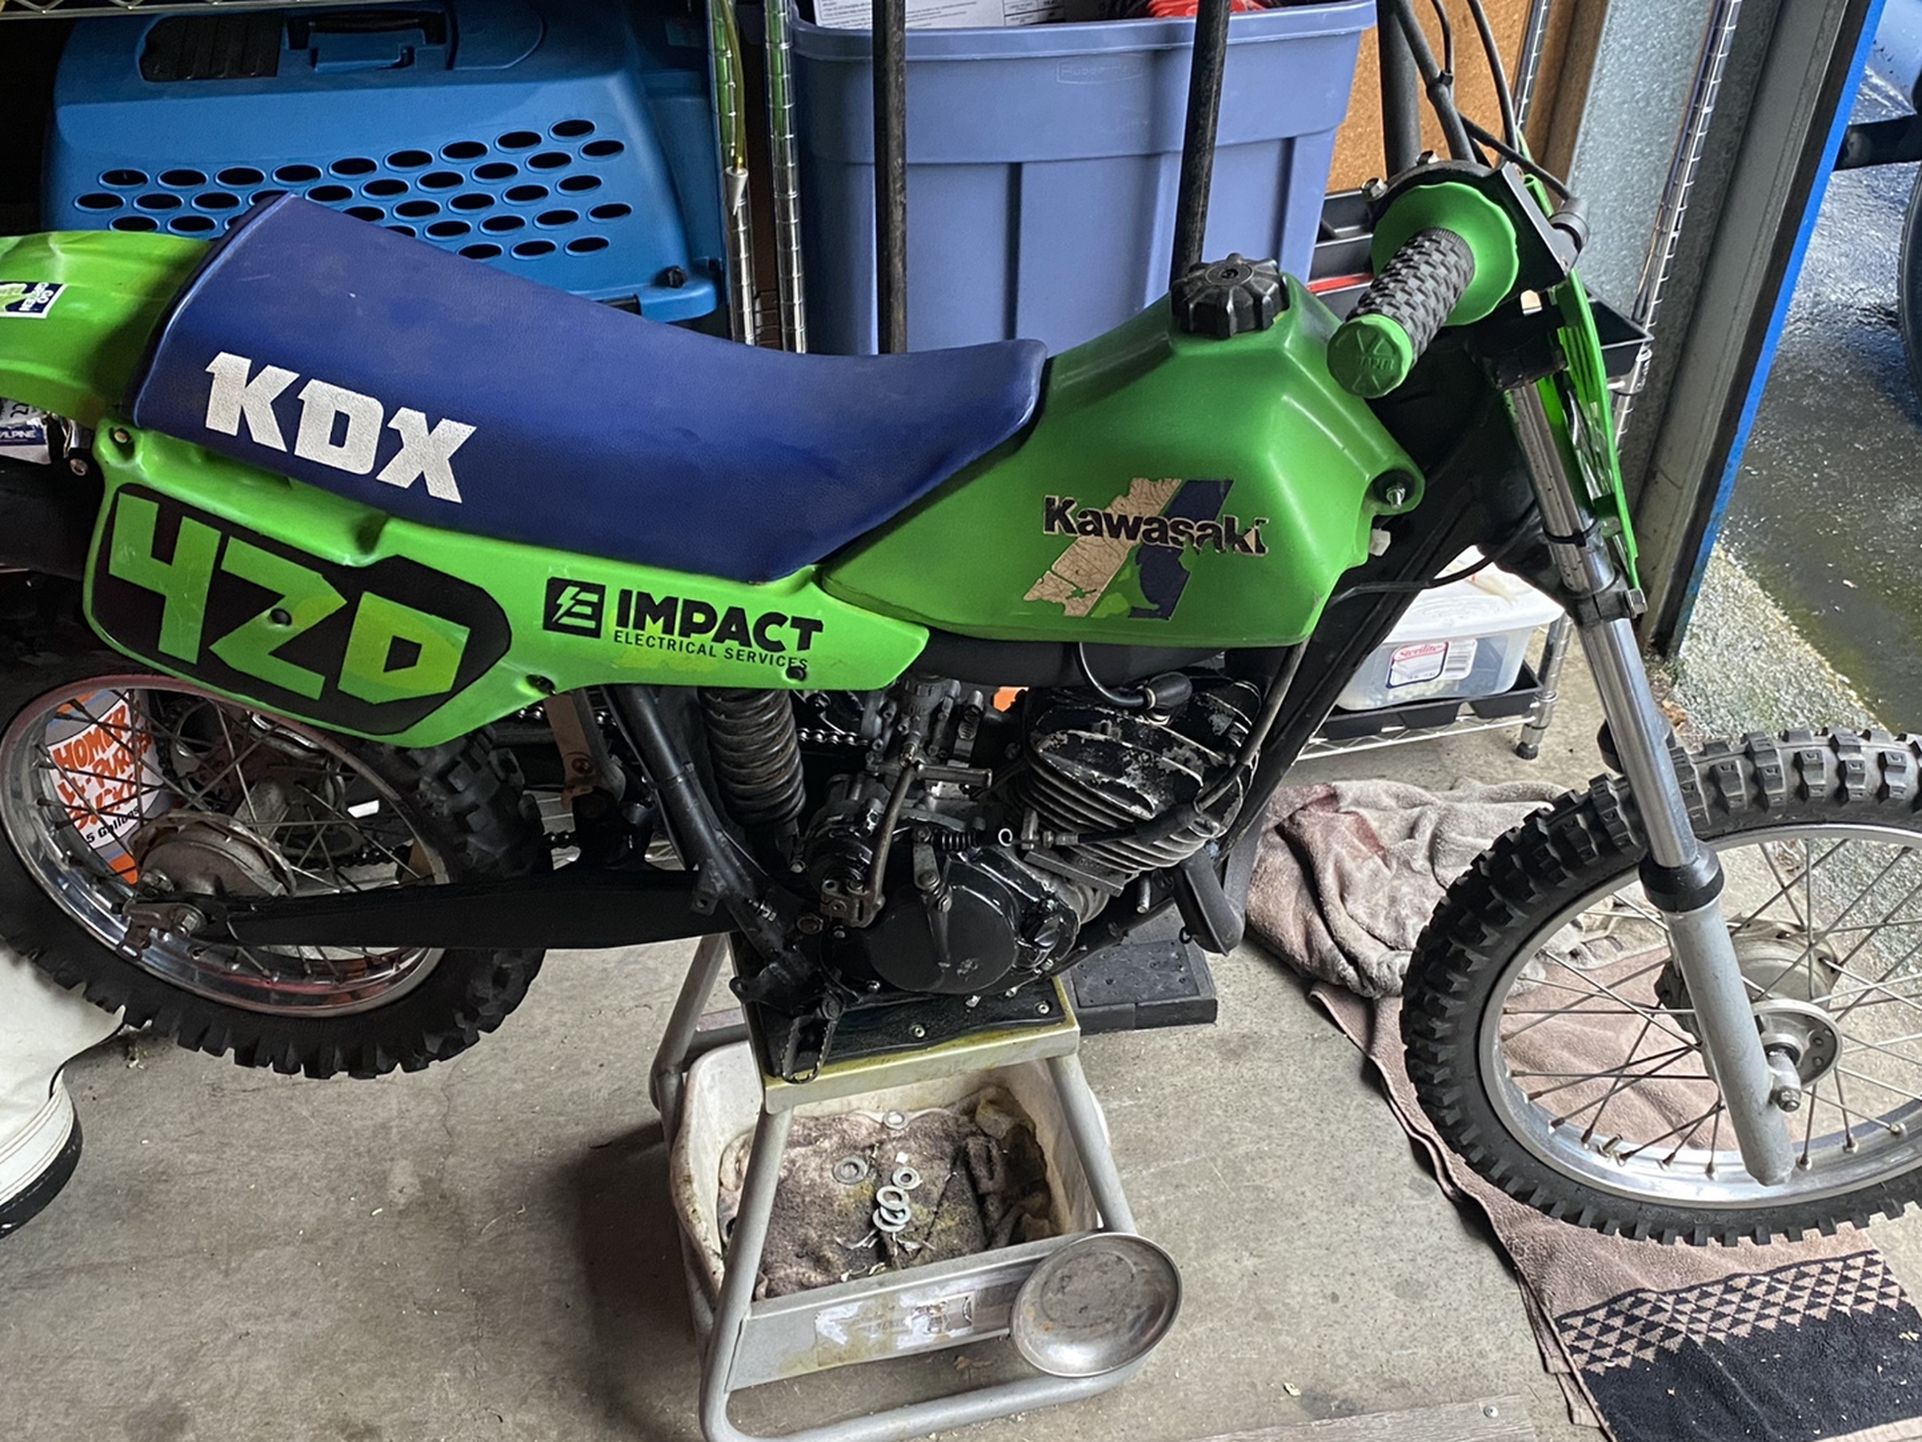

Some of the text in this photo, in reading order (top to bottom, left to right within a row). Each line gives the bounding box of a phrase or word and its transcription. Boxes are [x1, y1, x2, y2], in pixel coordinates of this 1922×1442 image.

[205, 351, 477, 504] KDX
[1043, 495, 1270, 557] Kawasaki
[613, 630, 809, 670] ELECTRICAL SERVICES
[615, 588, 825, 653] IMPACT
[86, 832, 95, 843] 5
